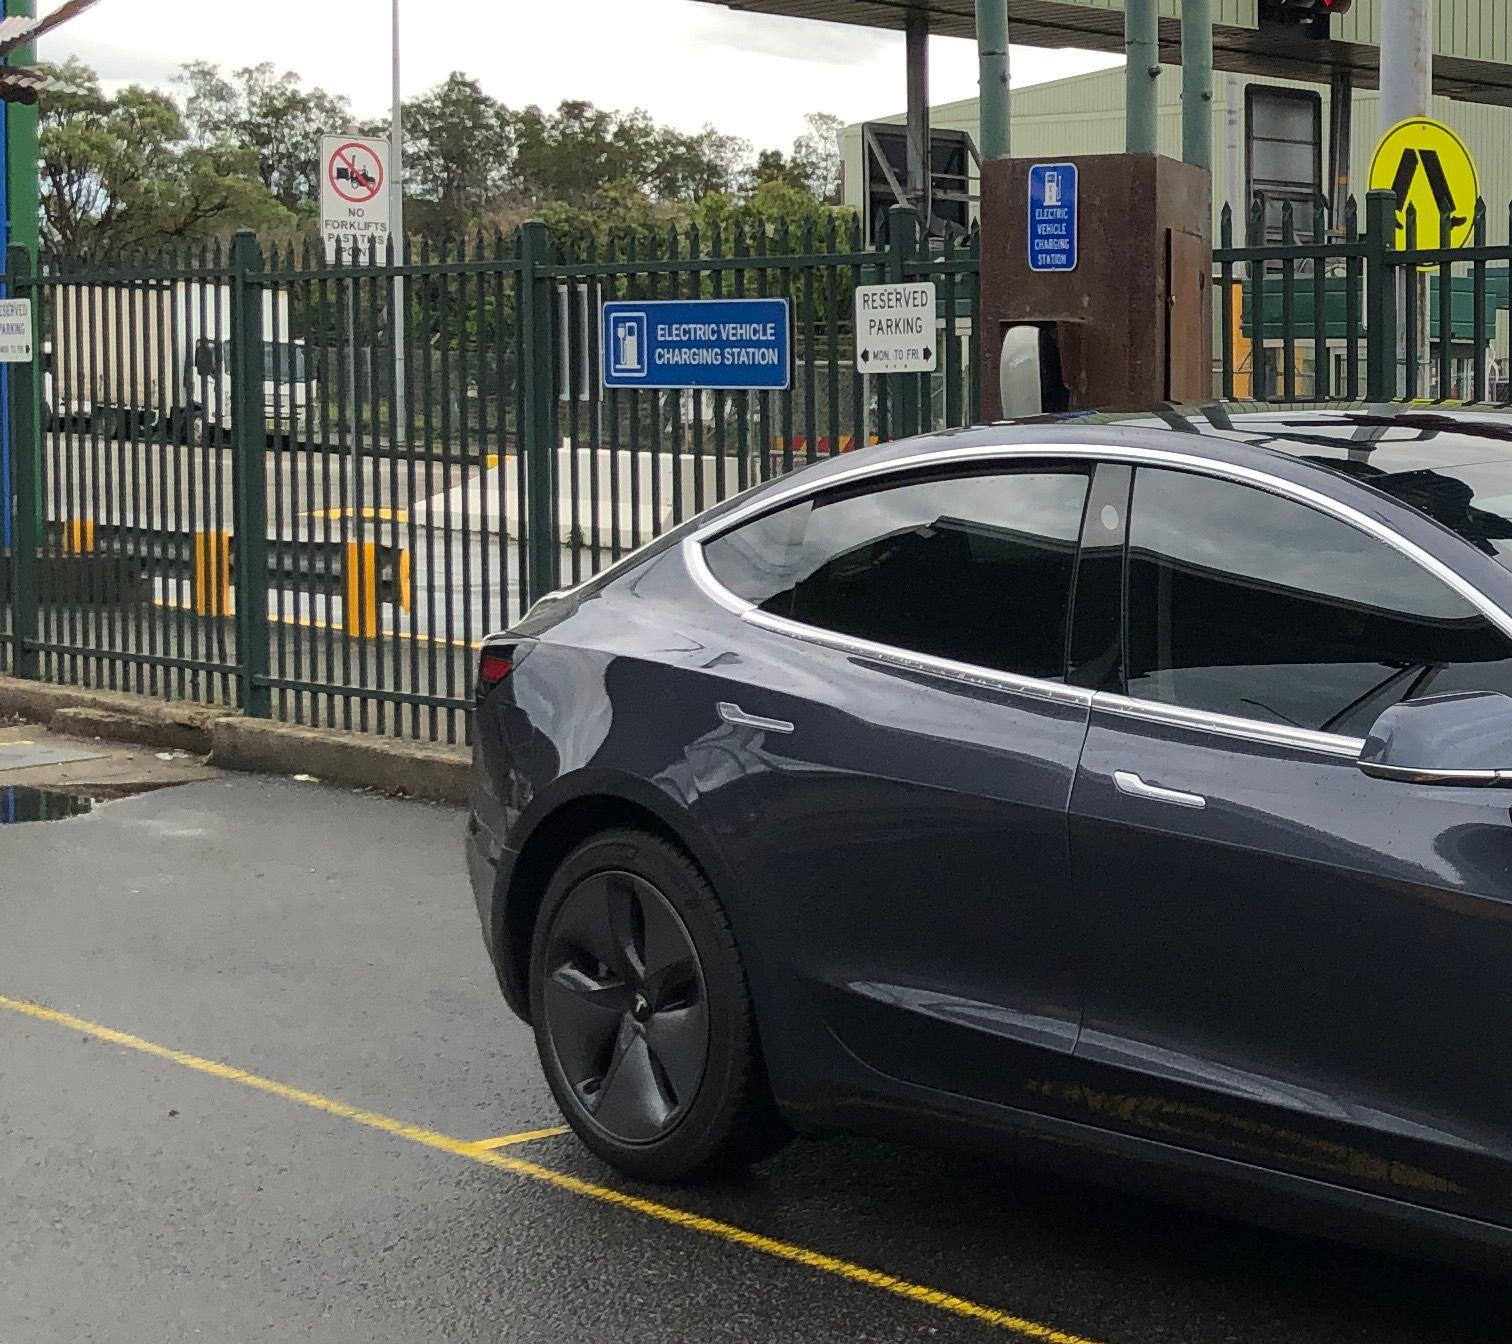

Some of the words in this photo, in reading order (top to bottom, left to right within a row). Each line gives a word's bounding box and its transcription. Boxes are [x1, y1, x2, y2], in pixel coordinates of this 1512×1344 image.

[348, 208, 365, 217] NO
[1035, 208, 1069, 219] ELECTRIC
[325, 220, 386, 232] FORKLIFTS
[1037, 223, 1067, 235] VEHICLE
[1034, 238, 1070, 250] CHARGING
[1038, 254, 1067, 265] STATION
[862, 290, 928, 310] RESERVED
[657, 324, 718, 341] ELECTRIC
[720, 323, 776, 341] VEHICLE
[869, 317, 923, 336] PARKING
[655, 348, 721, 365] CHARGING
[724, 348, 778, 365] STATION
[894, 349, 904, 360] TO
